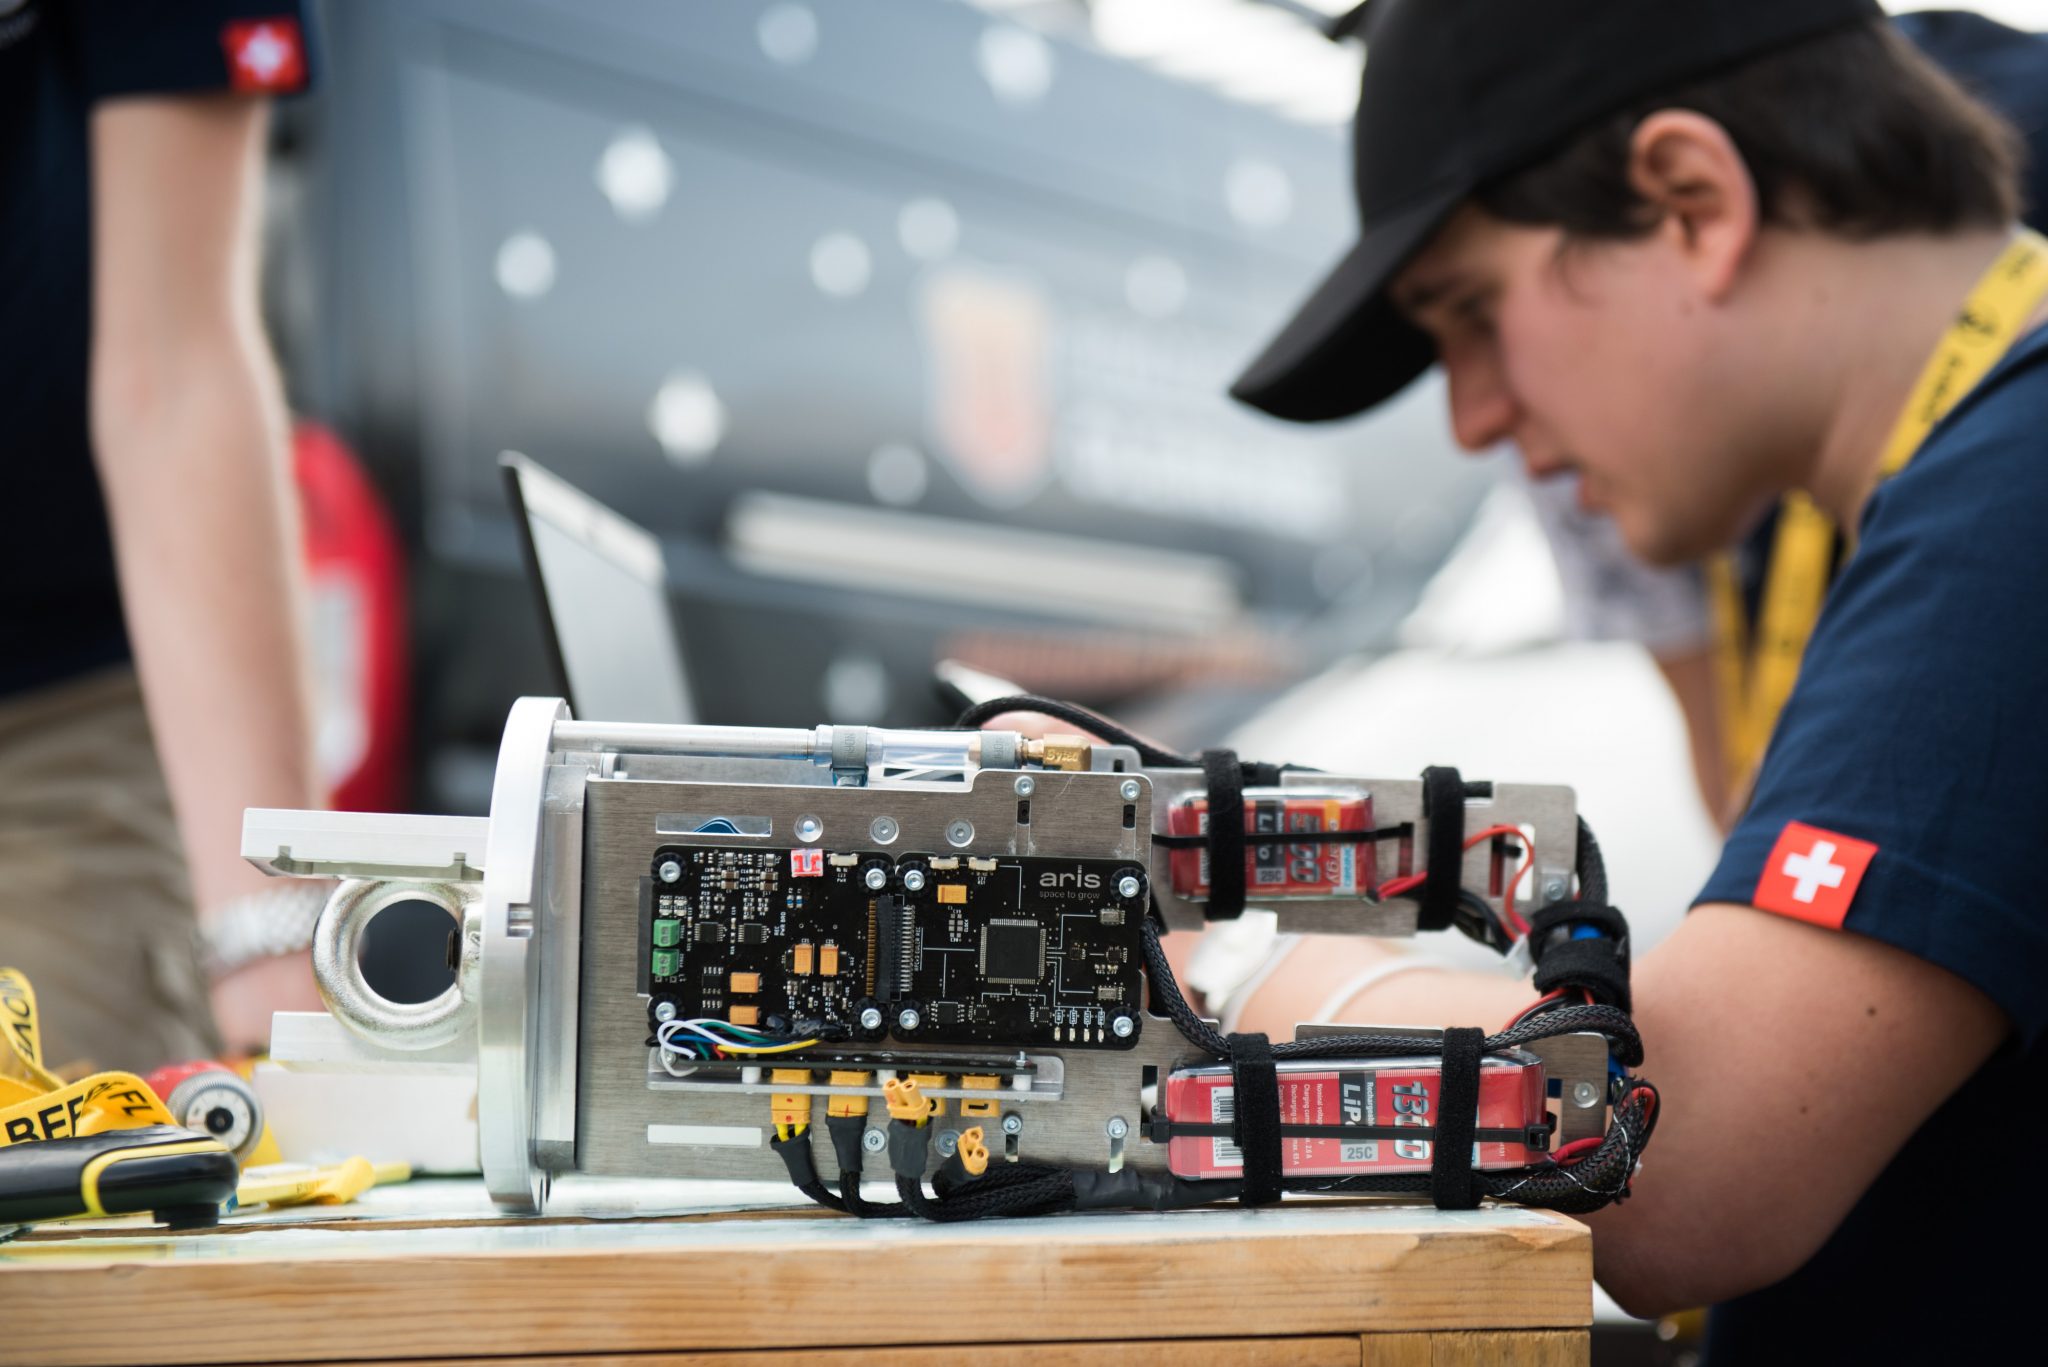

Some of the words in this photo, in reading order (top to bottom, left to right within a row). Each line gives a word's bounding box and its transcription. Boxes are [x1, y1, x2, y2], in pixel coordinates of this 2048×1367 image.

[1039, 864, 1101, 888] aris
[1039, 890, 1065, 900] space
[1067, 890, 1076, 899] to
[1078, 891, 1100, 900] grow
[1290, 1084, 1298, 1116] Discharging
[1302, 1084, 1311, 1108] Charging
[1316, 1084, 1324, 1106] Nominal
[1347, 1146, 1373, 1160] 25C
